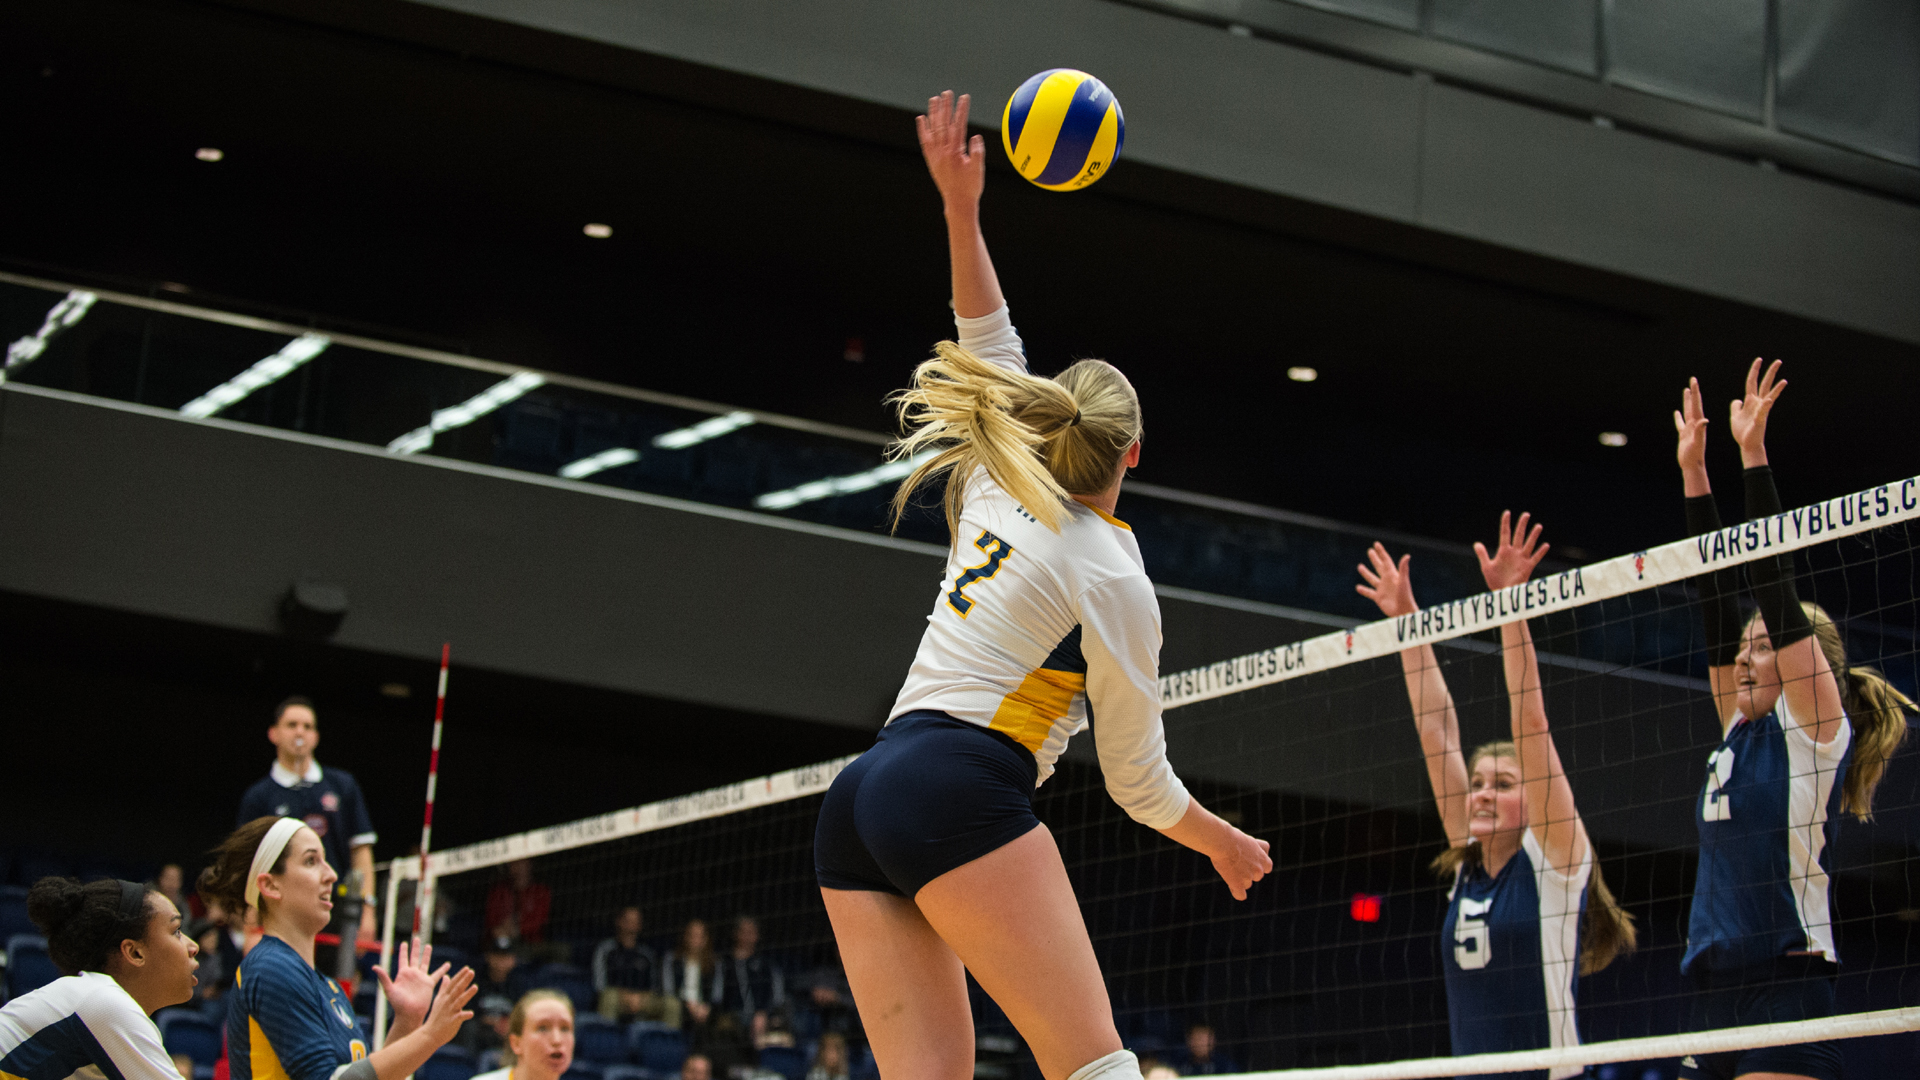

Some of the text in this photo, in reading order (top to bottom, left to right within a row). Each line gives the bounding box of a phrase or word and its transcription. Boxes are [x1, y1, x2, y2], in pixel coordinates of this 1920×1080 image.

[1698, 478, 1917, 564] VARSITYBLUES.C
[1397, 568, 1586, 643] VARSITYBLUES.CA
[1158, 641, 1306, 702] ARSITYBLUES.CA
[1703, 747, 1735, 822] 2
[1454, 897, 1492, 970] 5
